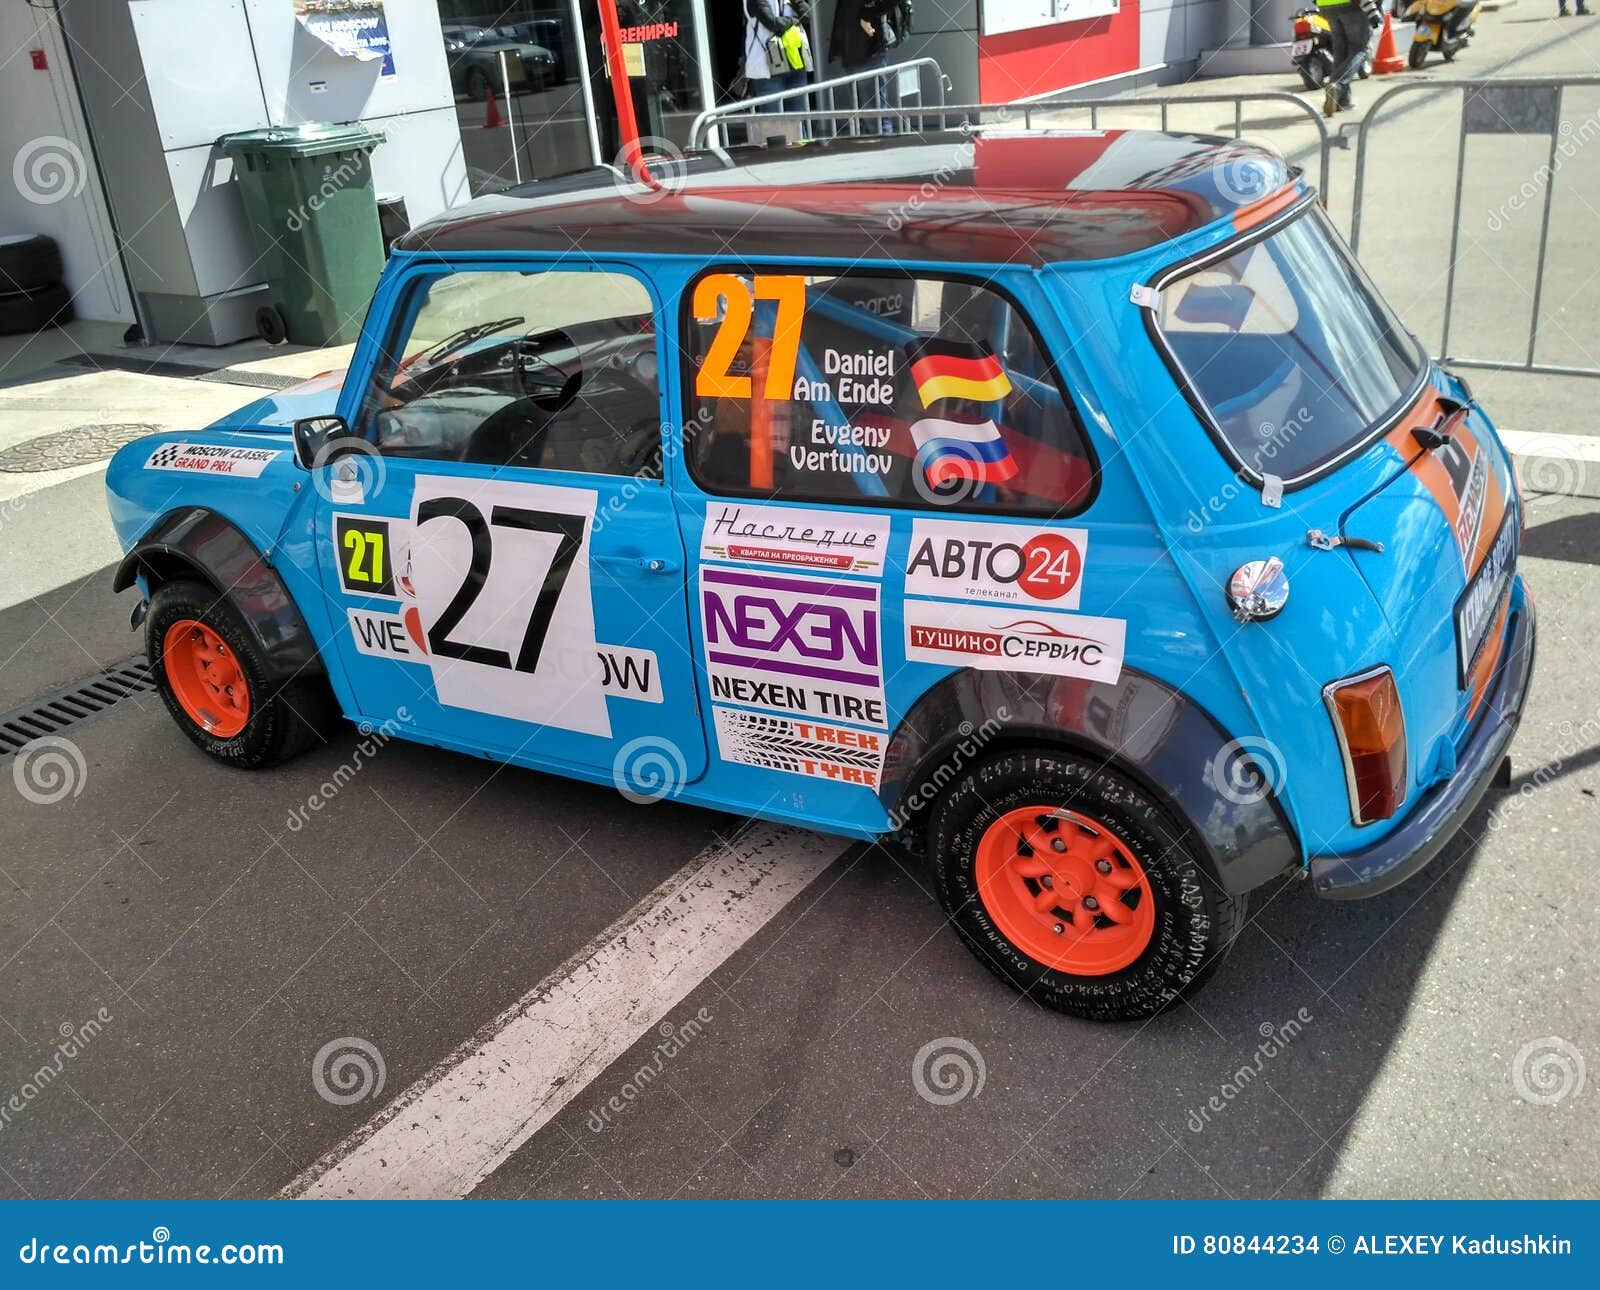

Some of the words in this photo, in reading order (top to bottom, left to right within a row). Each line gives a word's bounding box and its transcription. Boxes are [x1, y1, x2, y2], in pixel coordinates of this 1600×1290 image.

[600, 21, 678, 44] ВЕНИРЫ
[693, 273, 806, 400] 27
[824, 348, 894, 377] Daniel
[793, 376, 832, 401] Am
[838, 378, 894, 405] Ende
[811, 419, 891, 448] Evgeny
[174, 457, 208, 470] GRAND
[210, 460, 237, 472] PRIX
[183, 446, 231, 458] MOSCOW
[230, 449, 275, 461] CLASSIC
[790, 446, 892, 475] Vertunov
[712, 507, 877, 548] Наследие
[344, 529, 384, 584] 27
[740, 549, 770, 559] КВАРТАЛ
[771, 551, 780, 560] НА
[782, 552, 838, 565] ПРЕОБРАЖЕНКЕ
[416, 496, 588, 674] 27
[965, 587, 1018, 600] телеканал
[354, 616, 410, 654] WE
[704, 590, 878, 667] NEXEN
[711, 675, 807, 710] NEXEN
[813, 691, 883, 723] TIRE
[794, 723, 879, 750] TREK
[800, 760, 877, 788] TYRE
